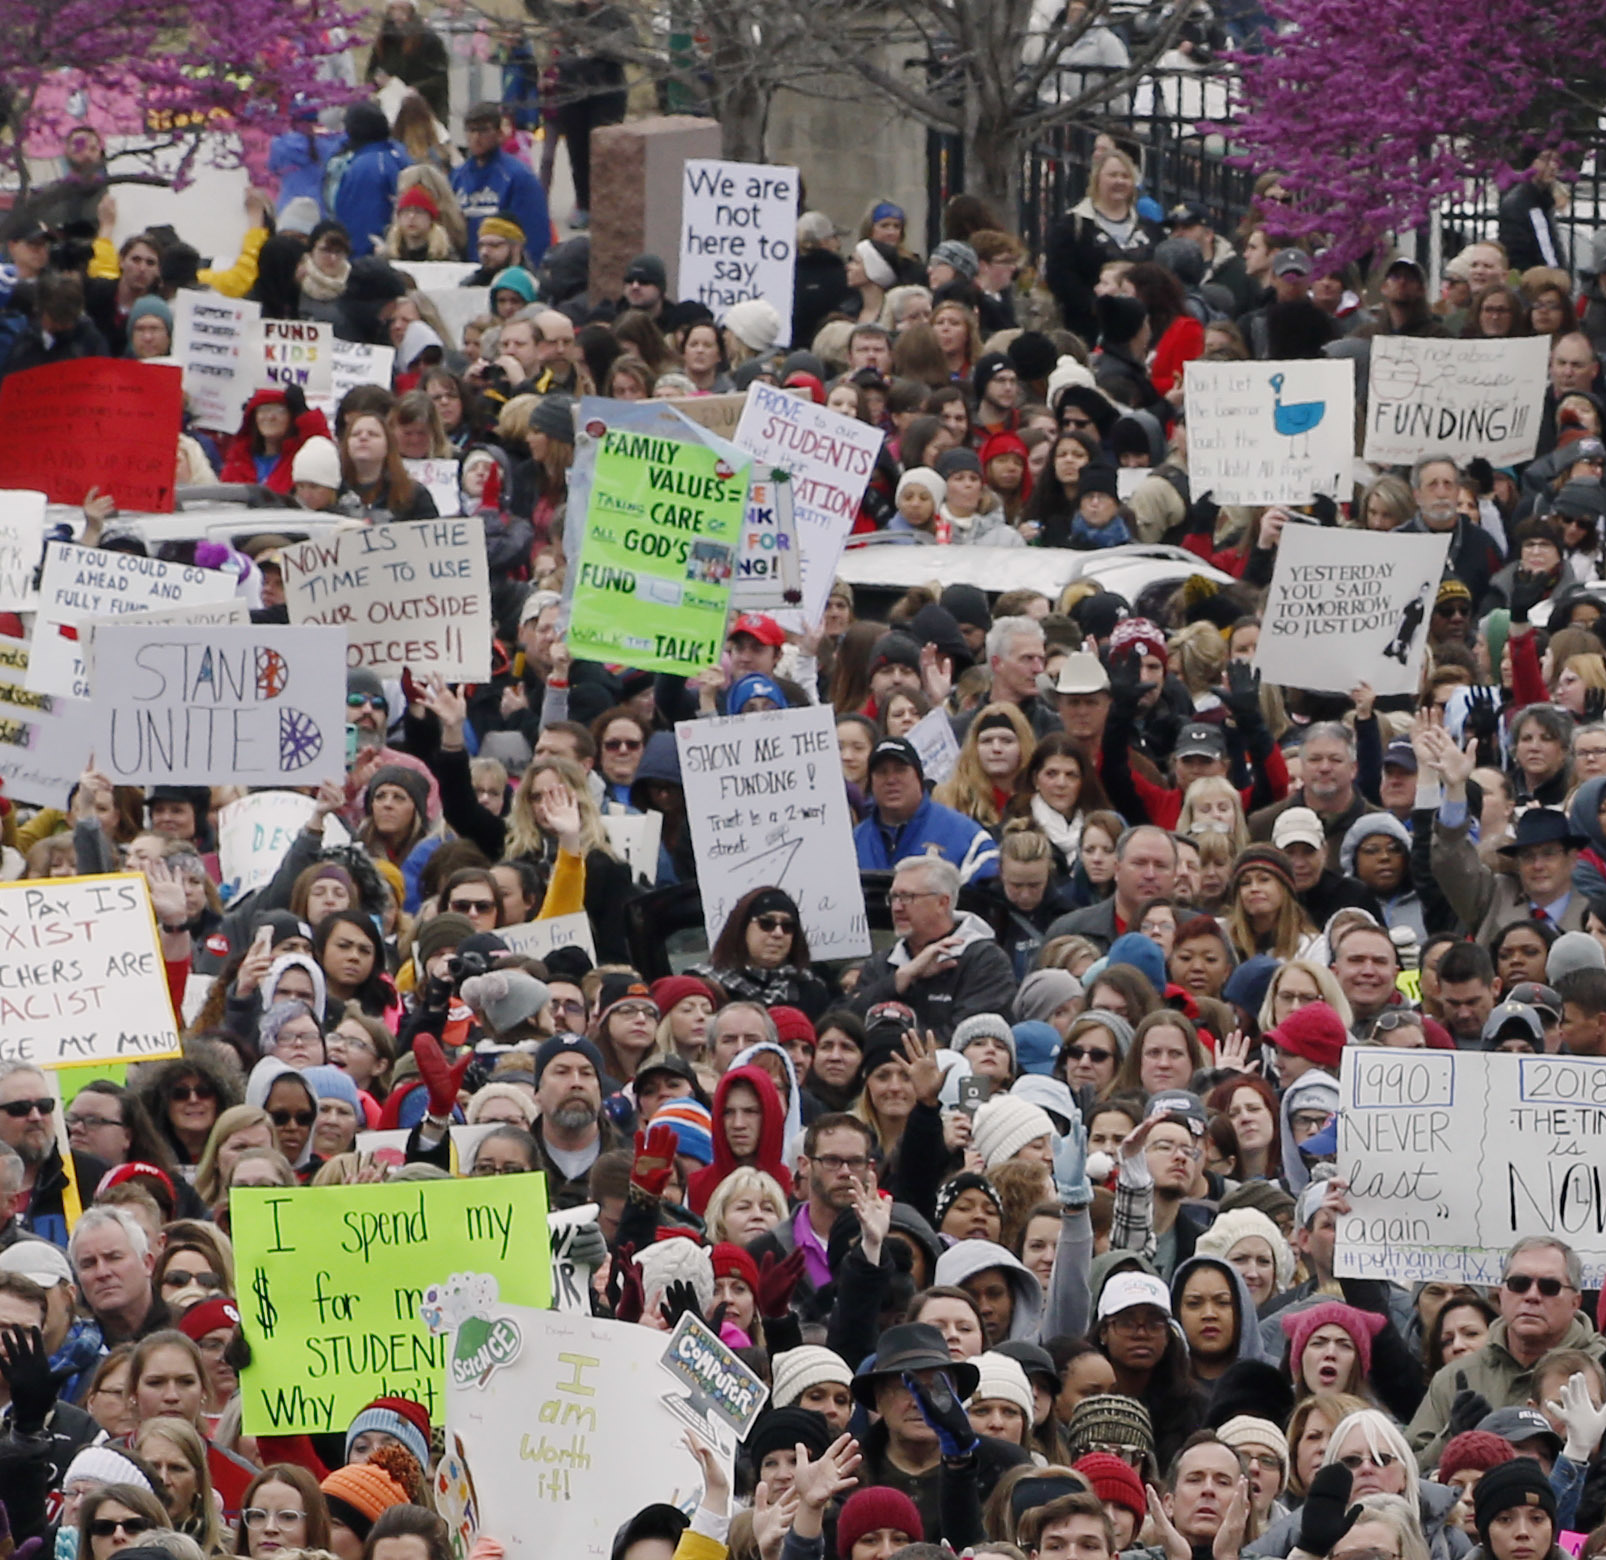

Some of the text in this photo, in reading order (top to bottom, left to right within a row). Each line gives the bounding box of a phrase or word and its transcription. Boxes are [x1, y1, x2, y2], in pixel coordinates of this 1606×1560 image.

[687, 168, 790, 200] We are
[716, 204, 761, 228] not
[688, 225, 789, 260] here to
[714, 261, 758, 286] say
[265, 323, 319, 340] FUND
[264, 345, 318, 361] KIDS
[266, 367, 310, 384] NOW
[602, 432, 681, 465] FAMILY
[650, 502, 705, 533] CARE
[580, 562, 636, 594] FUND
[1290, 563, 1397, 582] YESTERDAY
[1279, 581, 1382, 600] YOU SAID
[1276, 595, 1392, 618] TOMORROW
[1272, 619, 1299, 635] SO
[1303, 618, 1350, 638] JUST
[133, 642, 290, 701] STAND
[111, 706, 323, 775] UNITED
[1343, 1140, 1587, 1201] last is
